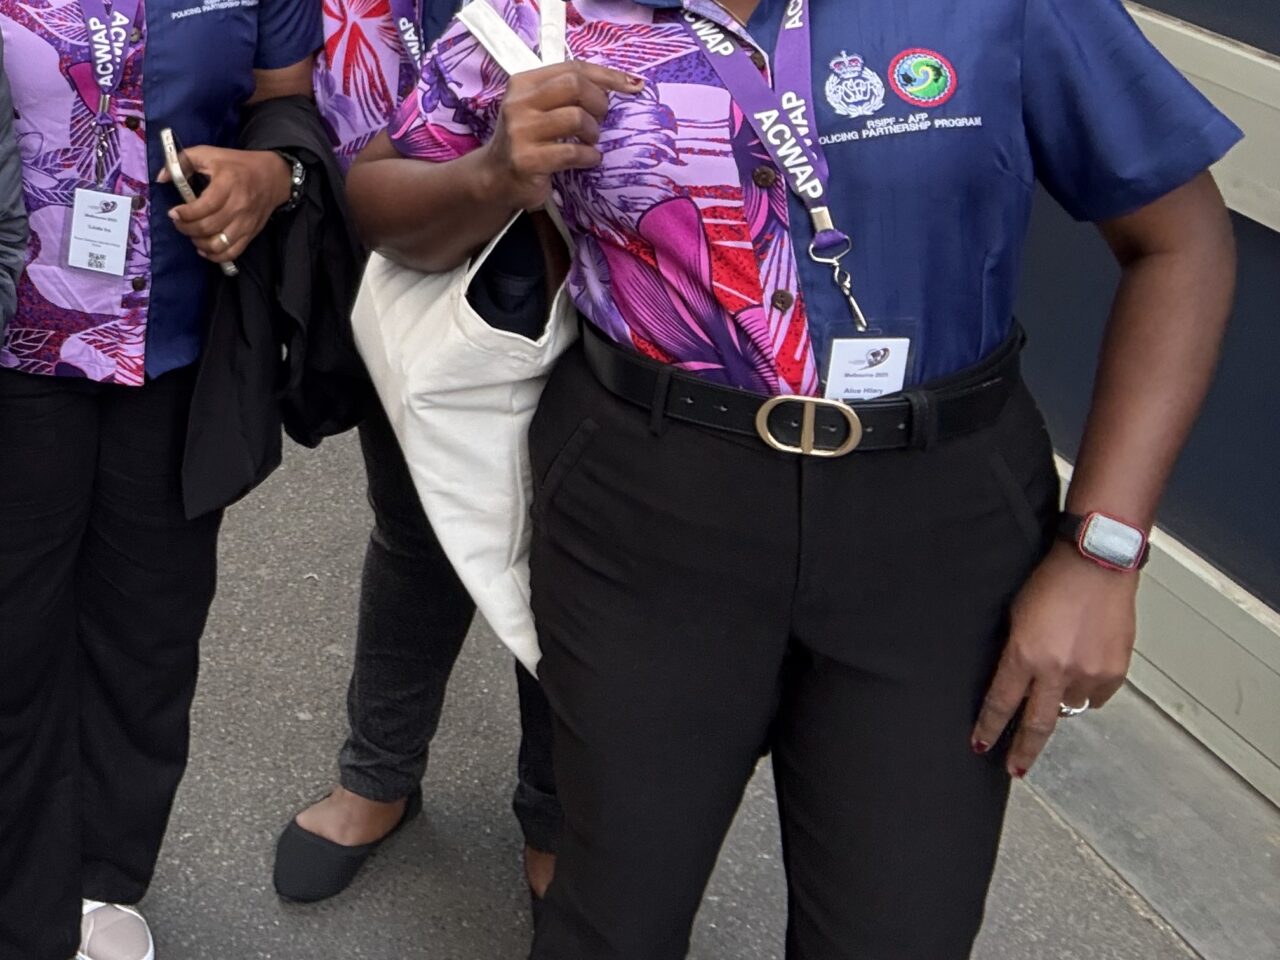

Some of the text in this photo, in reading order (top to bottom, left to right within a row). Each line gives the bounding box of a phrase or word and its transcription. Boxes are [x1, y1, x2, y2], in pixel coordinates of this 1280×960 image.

[88, 17, 115, 87] ACWAP
[818, 131, 859, 146] OLICING
[862, 121, 932, 139] PARTNERSHIP
[866, 117, 896, 129] RSIPF
[907, 112, 929, 124] AFP
[754, 108, 824, 200] ACWAP
